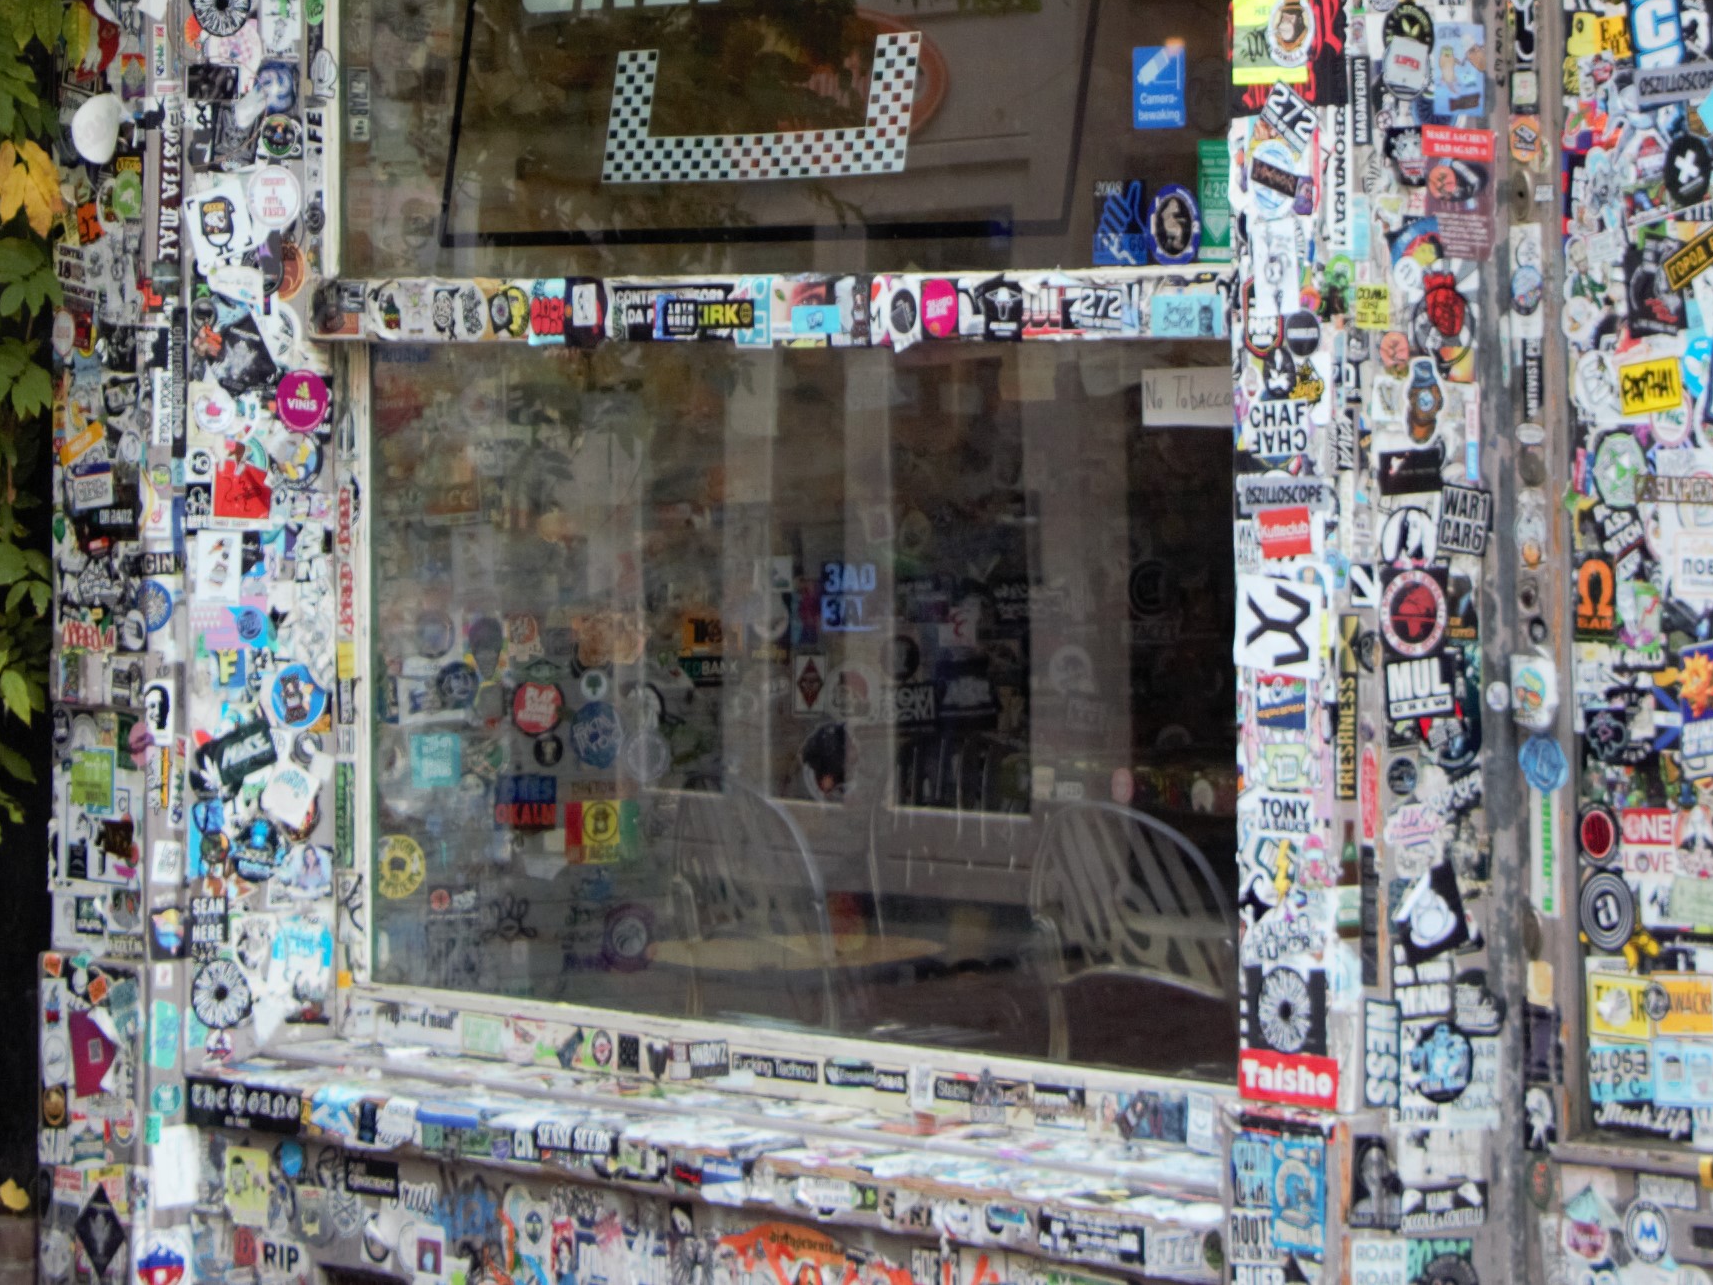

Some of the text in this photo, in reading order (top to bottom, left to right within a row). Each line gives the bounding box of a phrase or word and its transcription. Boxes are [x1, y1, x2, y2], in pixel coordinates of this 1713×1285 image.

[1139, 92, 1178, 106] Camera-
[1267, 86, 1318, 144] 272
[1203, 181, 1228, 197] 420
[1080, 287, 1122, 318] 272
[286, 396, 318, 413] VINIS
[1144, 373, 1232, 411] No Tobacco
[1249, 401, 1306, 429] CHAF
[1387, 658, 1452, 703] MUL
[1258, 797, 1312, 819] TONY
[191, 898, 225, 914] SEAN
[192, 923, 224, 942] HERE
[1241, 1059, 1333, 1098] Taisho
[263, 1241, 300, 1273] RIP
[1354, 1244, 1401, 1260] ROAR
